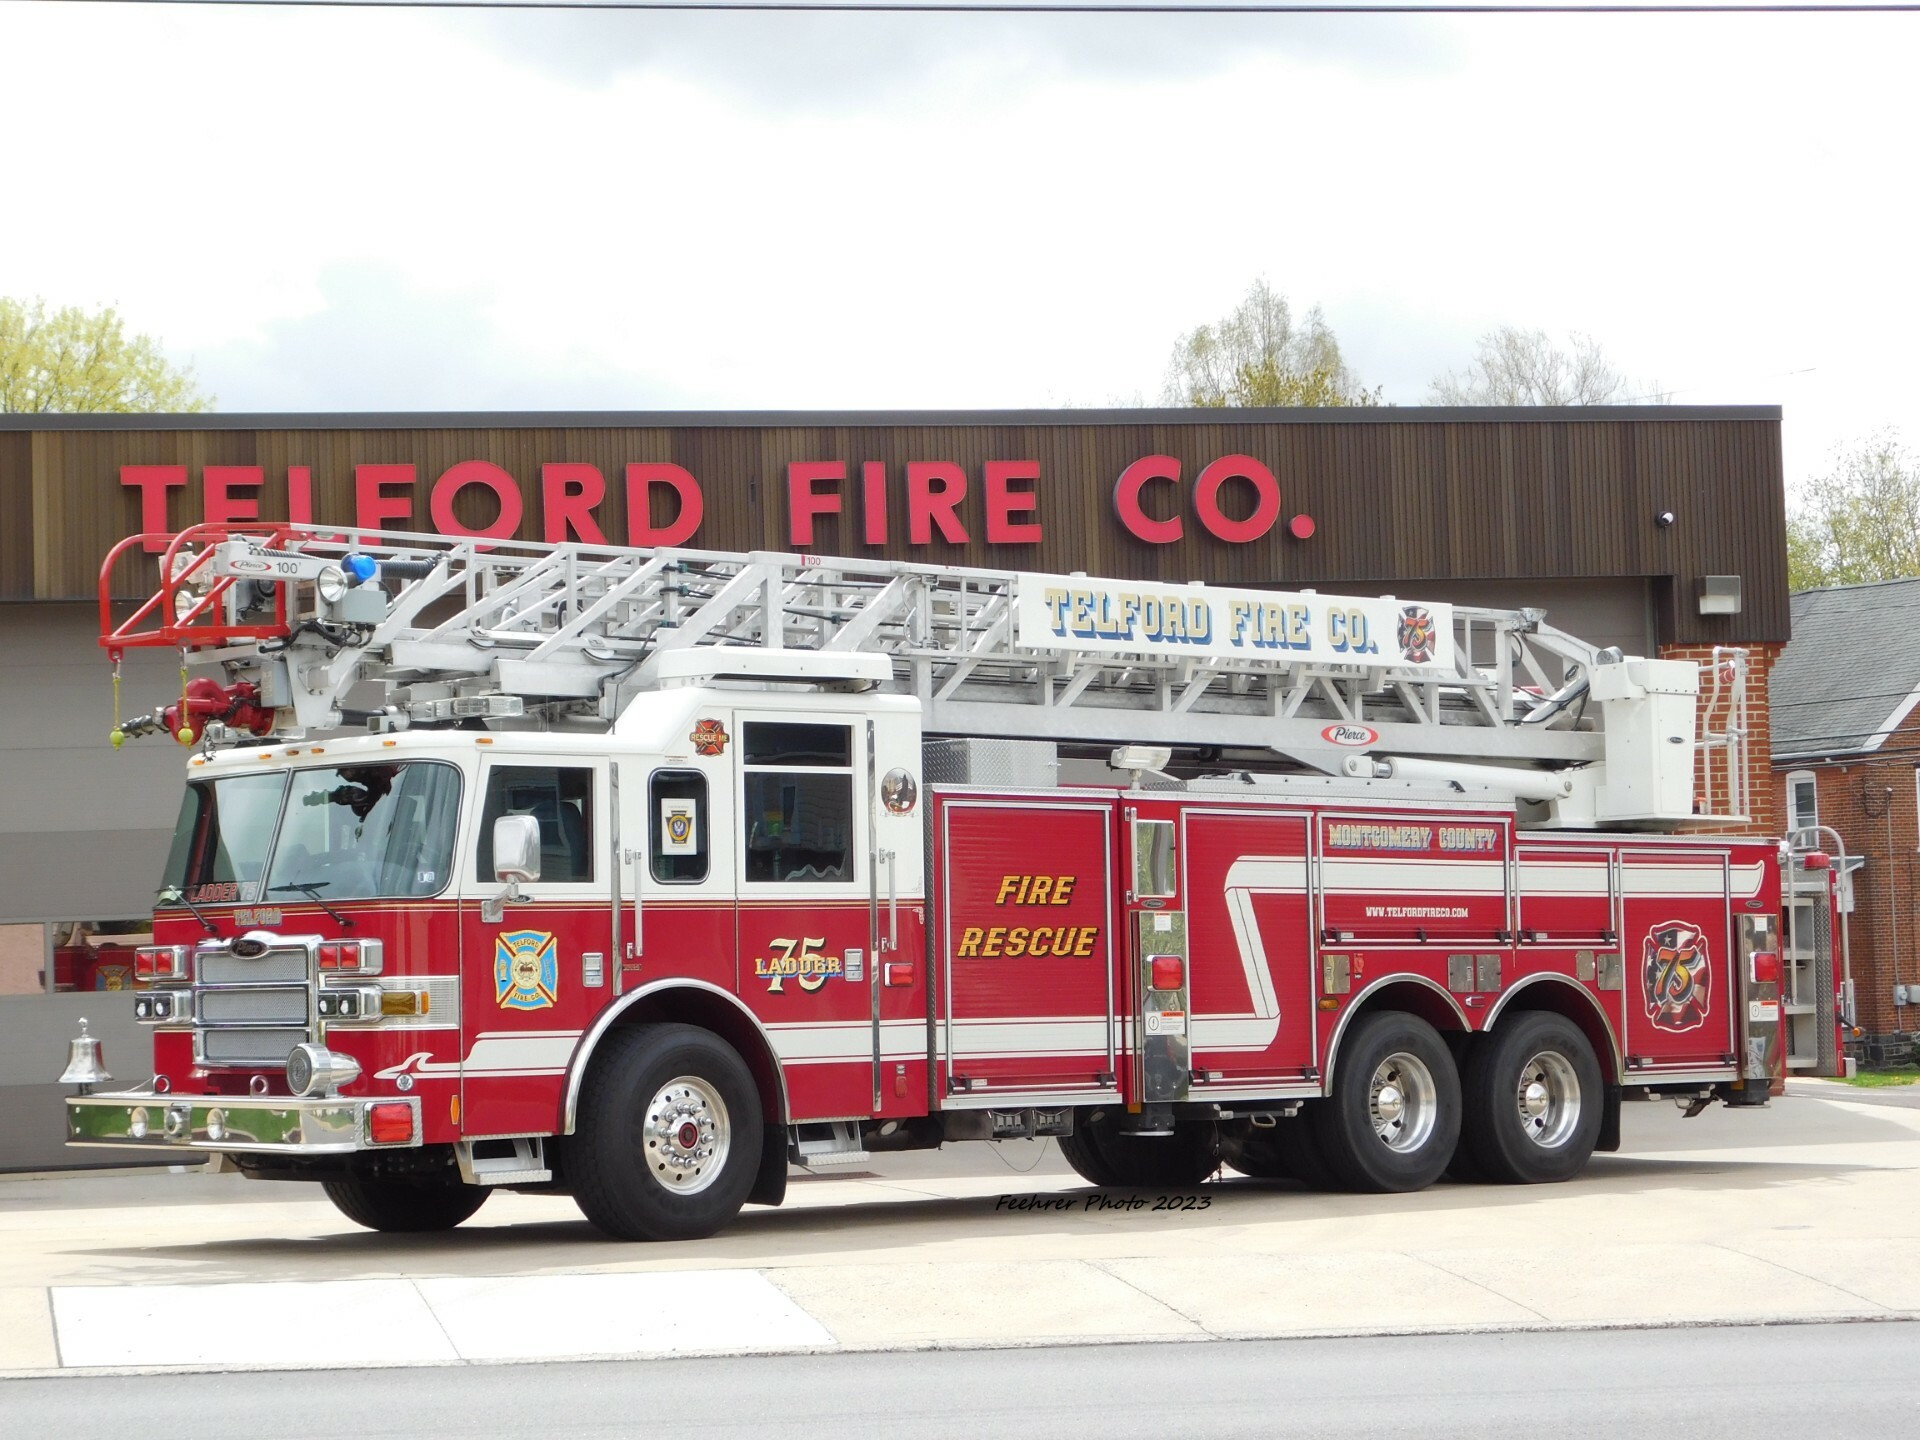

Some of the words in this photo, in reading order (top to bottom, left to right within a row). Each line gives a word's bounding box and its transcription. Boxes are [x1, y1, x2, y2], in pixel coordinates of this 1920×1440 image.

[120, 460, 703, 552] TELFORD
[788, 461, 1042, 545] FIRE
[1113, 454, 1315, 543] CO.
[807, 557, 821, 565] 100
[1045, 588, 1211, 644] TELFORD
[1229, 601, 1311, 651] FIRE
[1327, 607, 1378, 654] CO.
[1402, 618, 1432, 650] 75
[691, 734, 716, 742] RESCUE
[1334, 726, 1366, 741] Pierce
[1329, 824, 1432, 850] MONTGOMERY
[1438, 827, 1497, 852] COUNTY
[190, 883, 239, 902] LADDER
[240, 881, 259, 900] 75
[995, 875, 1076, 905] FIRE
[233, 908, 282, 927] TELFORD
[1365, 907, 1469, 918] WWW.TELFORDFIRECO.COM
[513, 938, 540, 949] TELFORD
[957, 927, 1099, 957] RESCUE
[754, 956, 843, 978] LADDER
[767, 936, 826, 992] 75
[1655, 947, 1699, 1003] 75
